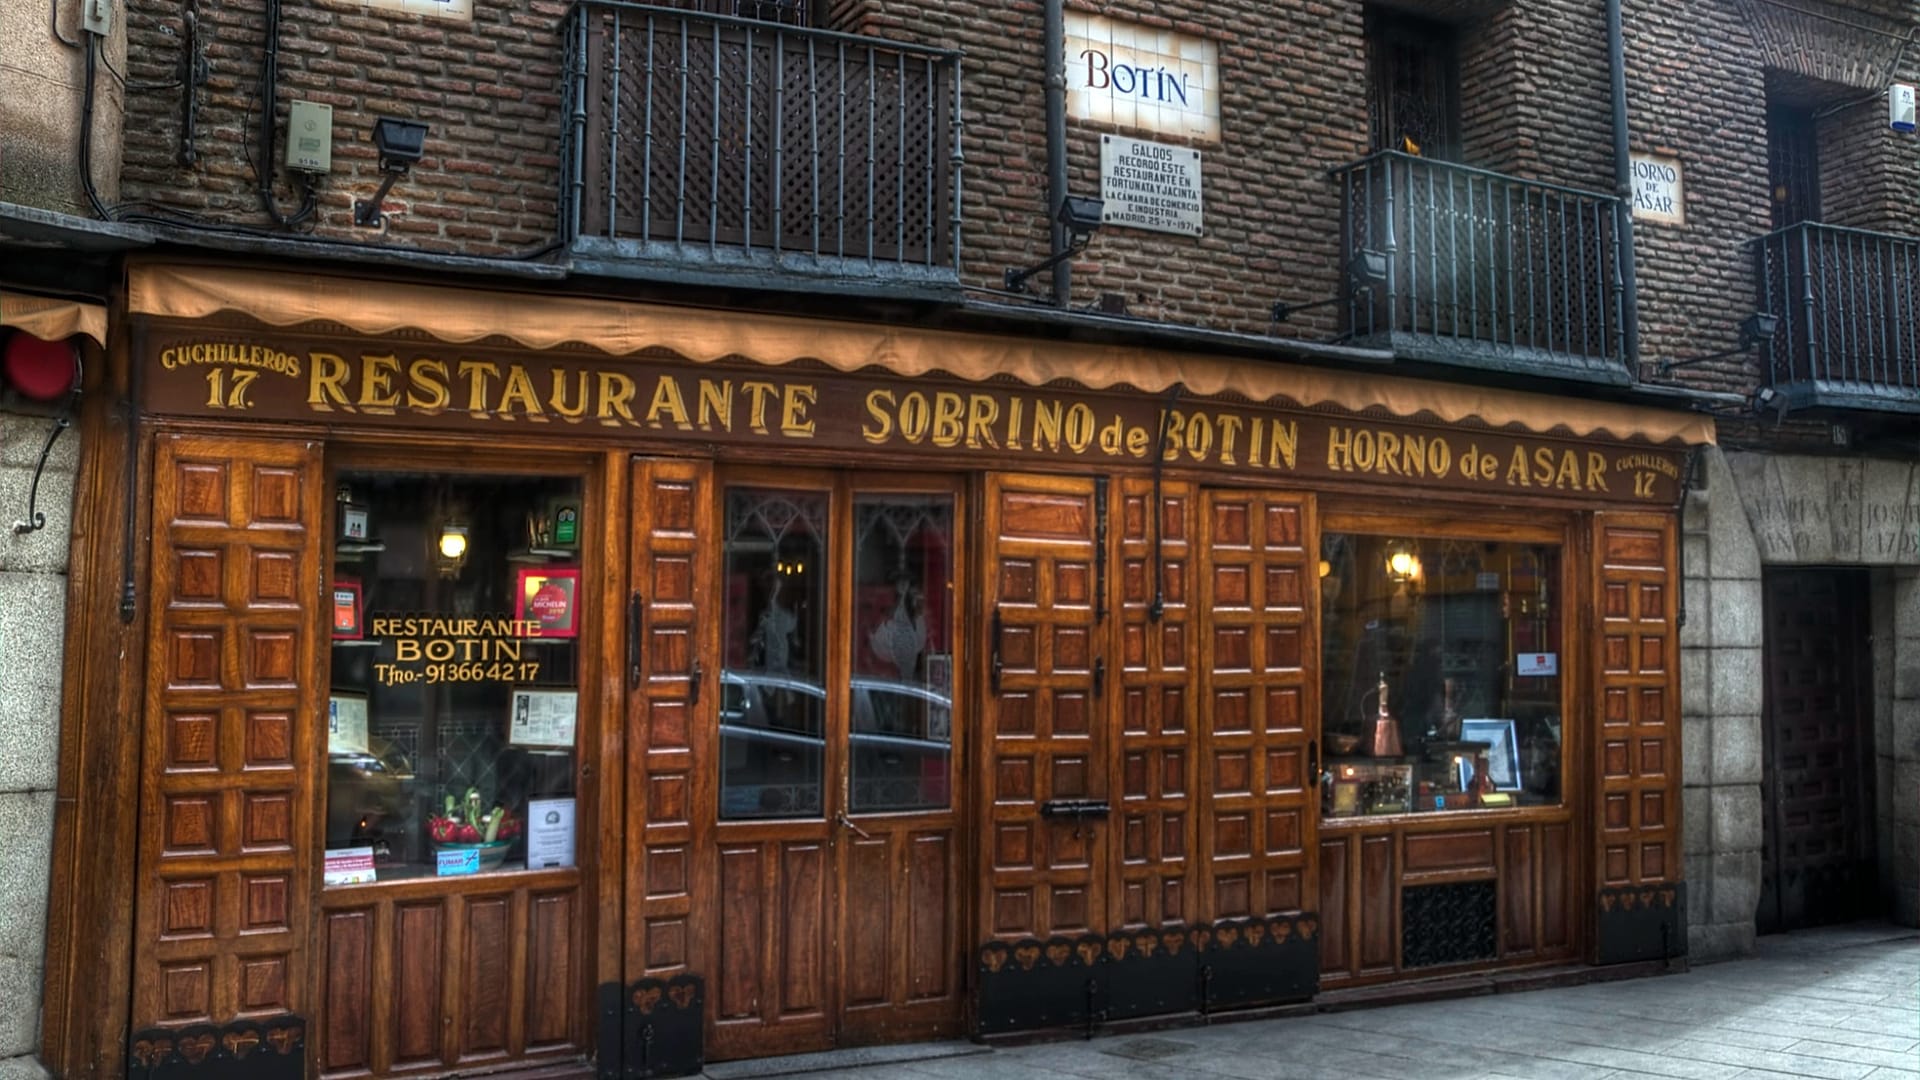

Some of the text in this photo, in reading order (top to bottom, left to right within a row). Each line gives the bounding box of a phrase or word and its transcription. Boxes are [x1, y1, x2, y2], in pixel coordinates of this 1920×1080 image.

[1114, 166, 1191, 187] RESTAURANTE EN
[1162, 162, 1185, 175] ESTE
[1156, 185, 1161, 194] Y
[1646, 182, 1659, 193] DE
[1105, 191, 1116, 200] LA
[1150, 198, 1160, 206] DE
[1161, 200, 1199, 212] COMERCIO
[1128, 204, 1133, 212] E
[1634, 187, 1674, 215] ASAR
[307, 352, 1610, 492] RESTAURANTE SOBRINO de BOTIN HORNO de ASAR
[533, 600, 567, 608] MICHELIN
[372, 618, 543, 636] RESTAURANTE
[396, 639, 521, 661] BOTIN
